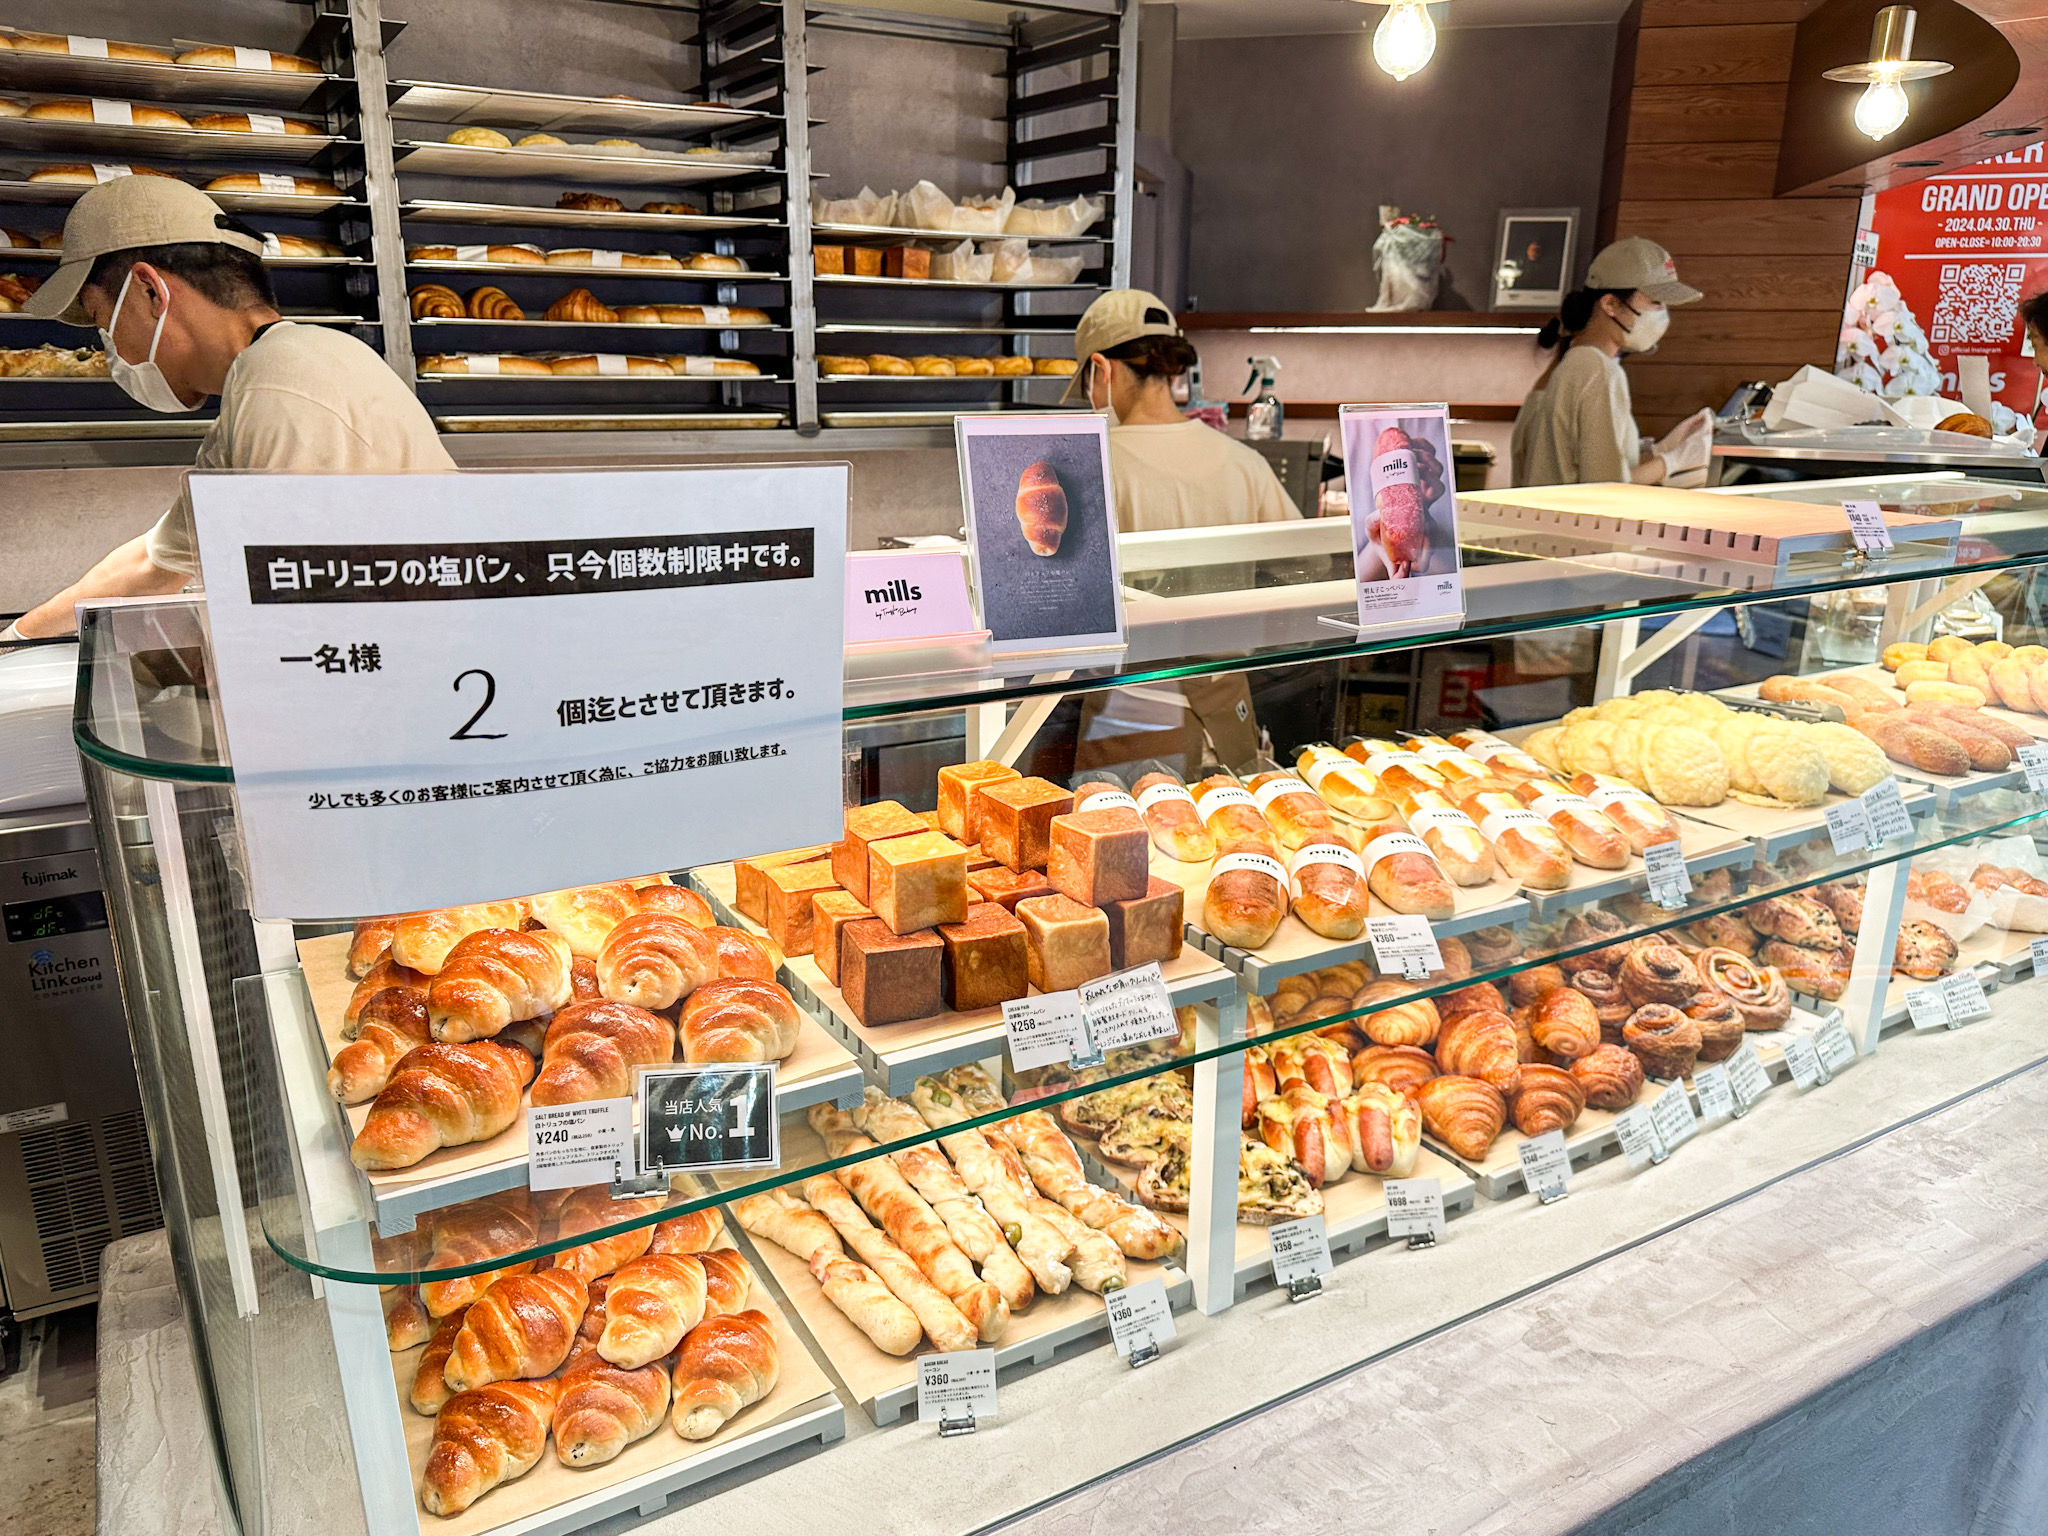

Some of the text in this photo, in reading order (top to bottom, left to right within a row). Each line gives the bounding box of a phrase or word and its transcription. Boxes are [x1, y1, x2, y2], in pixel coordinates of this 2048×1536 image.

[1921, 184, 2003, 212] GRAND
[1383, 458, 1408, 472] mills
[267, 544, 802, 591] 白トリュフの塩パン、只今個数制限中です。
[864, 579, 922, 604] mills
[1437, 581, 1453, 590] mills
[280, 643, 383, 674] 一名様
[449, 669, 796, 741] 2 個迄とさせて頂きます。
[308, 744, 788, 810] 少しでも多くのお客様にご案内させて頂く為に、ご協力をお願い致します。
[1309, 849, 1349, 859] mills
[1238, 857, 1278, 871] mills
[22, 868, 78, 886] fujimak
[1374, 933, 1395, 943] ¥360
[28, 957, 100, 977] Kitchen
[32, 972, 102, 992] Link Cloud
[1010, 1018, 1036, 1033] ¥258
[535, 1113, 547, 1121] SALT
[572, 1109, 587, 1117] WHITE
[588, 1106, 609, 1115] TRUFFLE
[664, 1098, 723, 1116] 当店人気
[535, 1118, 585, 1129] 白トリュフの塩パン
[536, 1129, 569, 1145] ¥240
[1274, 1240, 1292, 1253] ¥358
[1112, 1307, 1132, 1321] ¥360
[925, 1373, 949, 1386] ¥360
